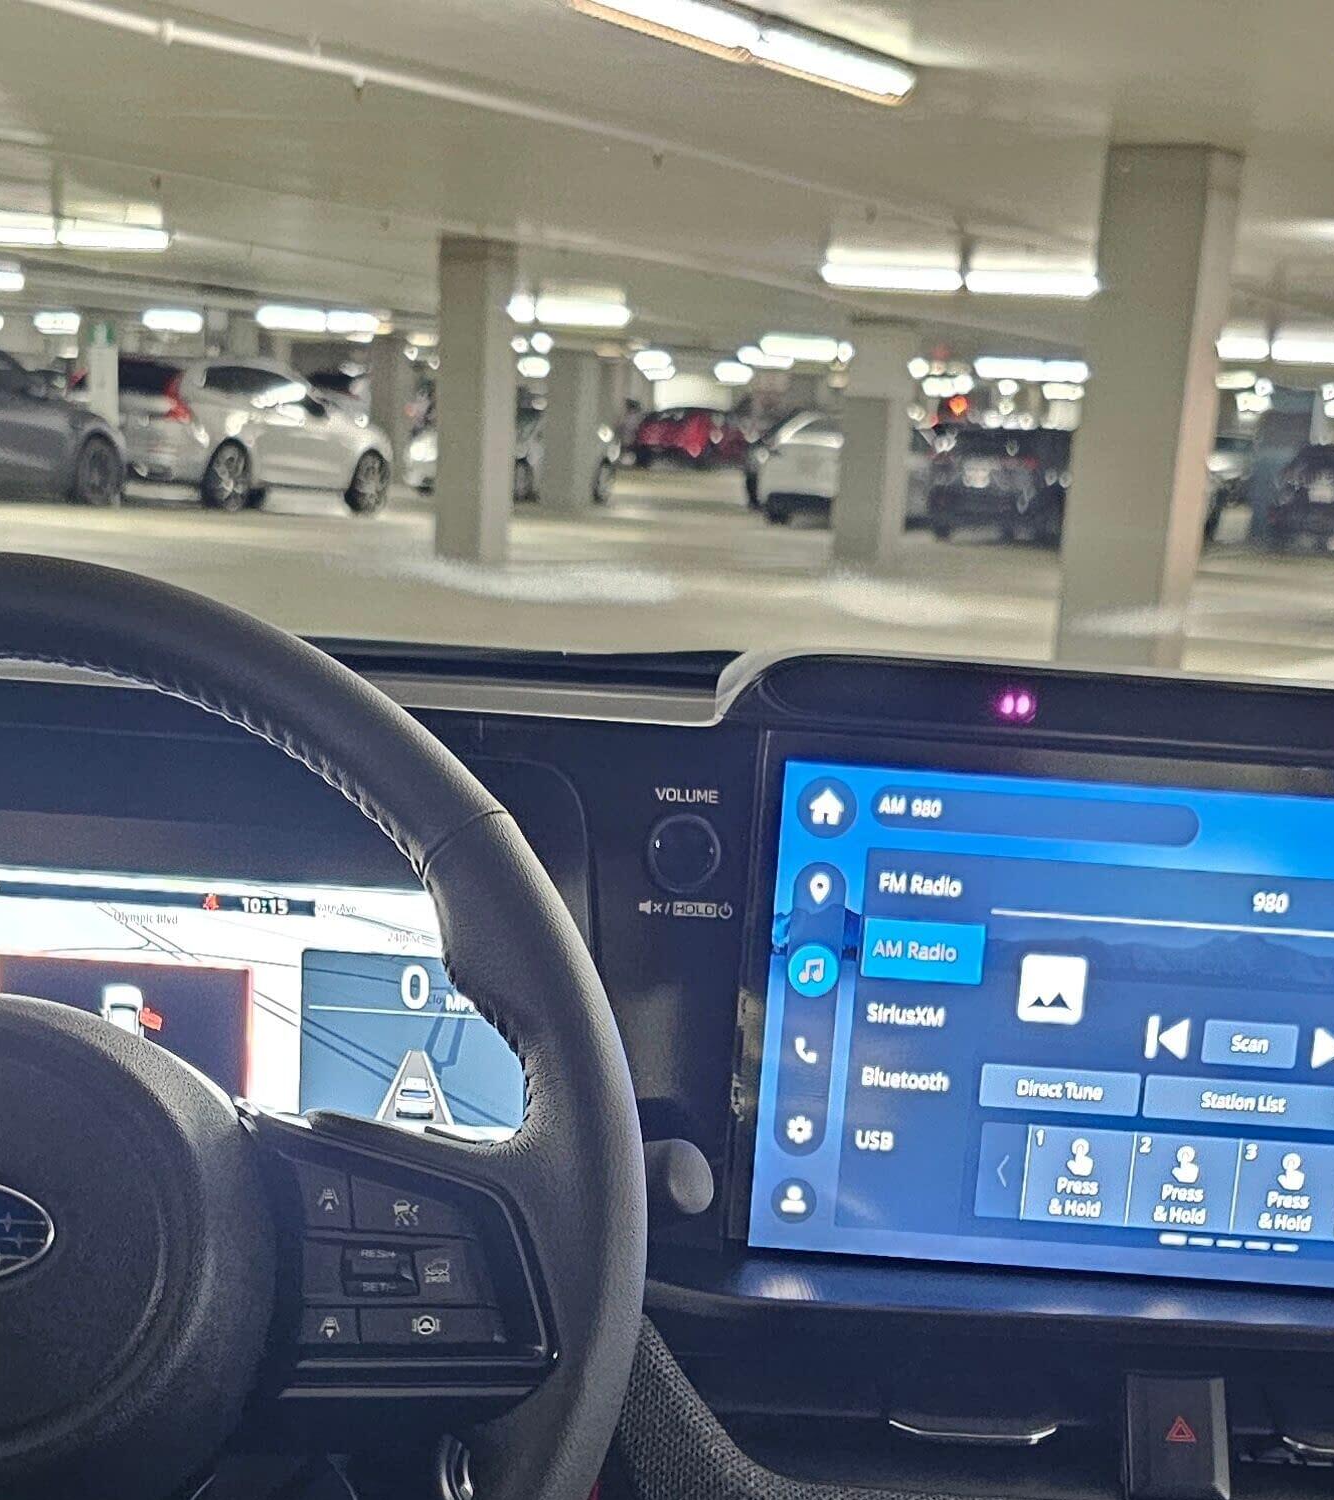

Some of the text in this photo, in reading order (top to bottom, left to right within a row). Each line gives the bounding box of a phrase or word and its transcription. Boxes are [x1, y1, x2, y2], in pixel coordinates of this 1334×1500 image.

[655, 787, 720, 804] VOLUME
[879, 796, 942, 819] AM 980
[879, 872, 963, 898] FM Radio
[241, 897, 289, 915] 10:15
[1252, 892, 1290, 914] 980
[113, 911, 178, 927] Olympic Blvd
[872, 939, 957, 962] AM Radio
[401, 964, 430, 1010] 0
[867, 1002, 946, 1028] SiriusXM
[1230, 1033, 1269, 1054] Scan
[861, 1066, 949, 1092] Bluetooth
[1017, 1079, 1104, 1101] Direct Tune
[1200, 1091, 1287, 1114] Station List
[855, 1130, 895, 1151] USB
[1035, 1129, 1046, 1147] 1
[1139, 1136, 1152, 1154] 2
[1245, 1143, 1259, 1161] 3
[1056, 1176, 1099, 1196] Press
[1161, 1183, 1204, 1203] Press
[1048, 1198, 1102, 1219] & Hold
[1267, 1190, 1310, 1210] Press
[1153, 1205, 1206, 1226] & Hold
[1257, 1212, 1312, 1232] & Hold
